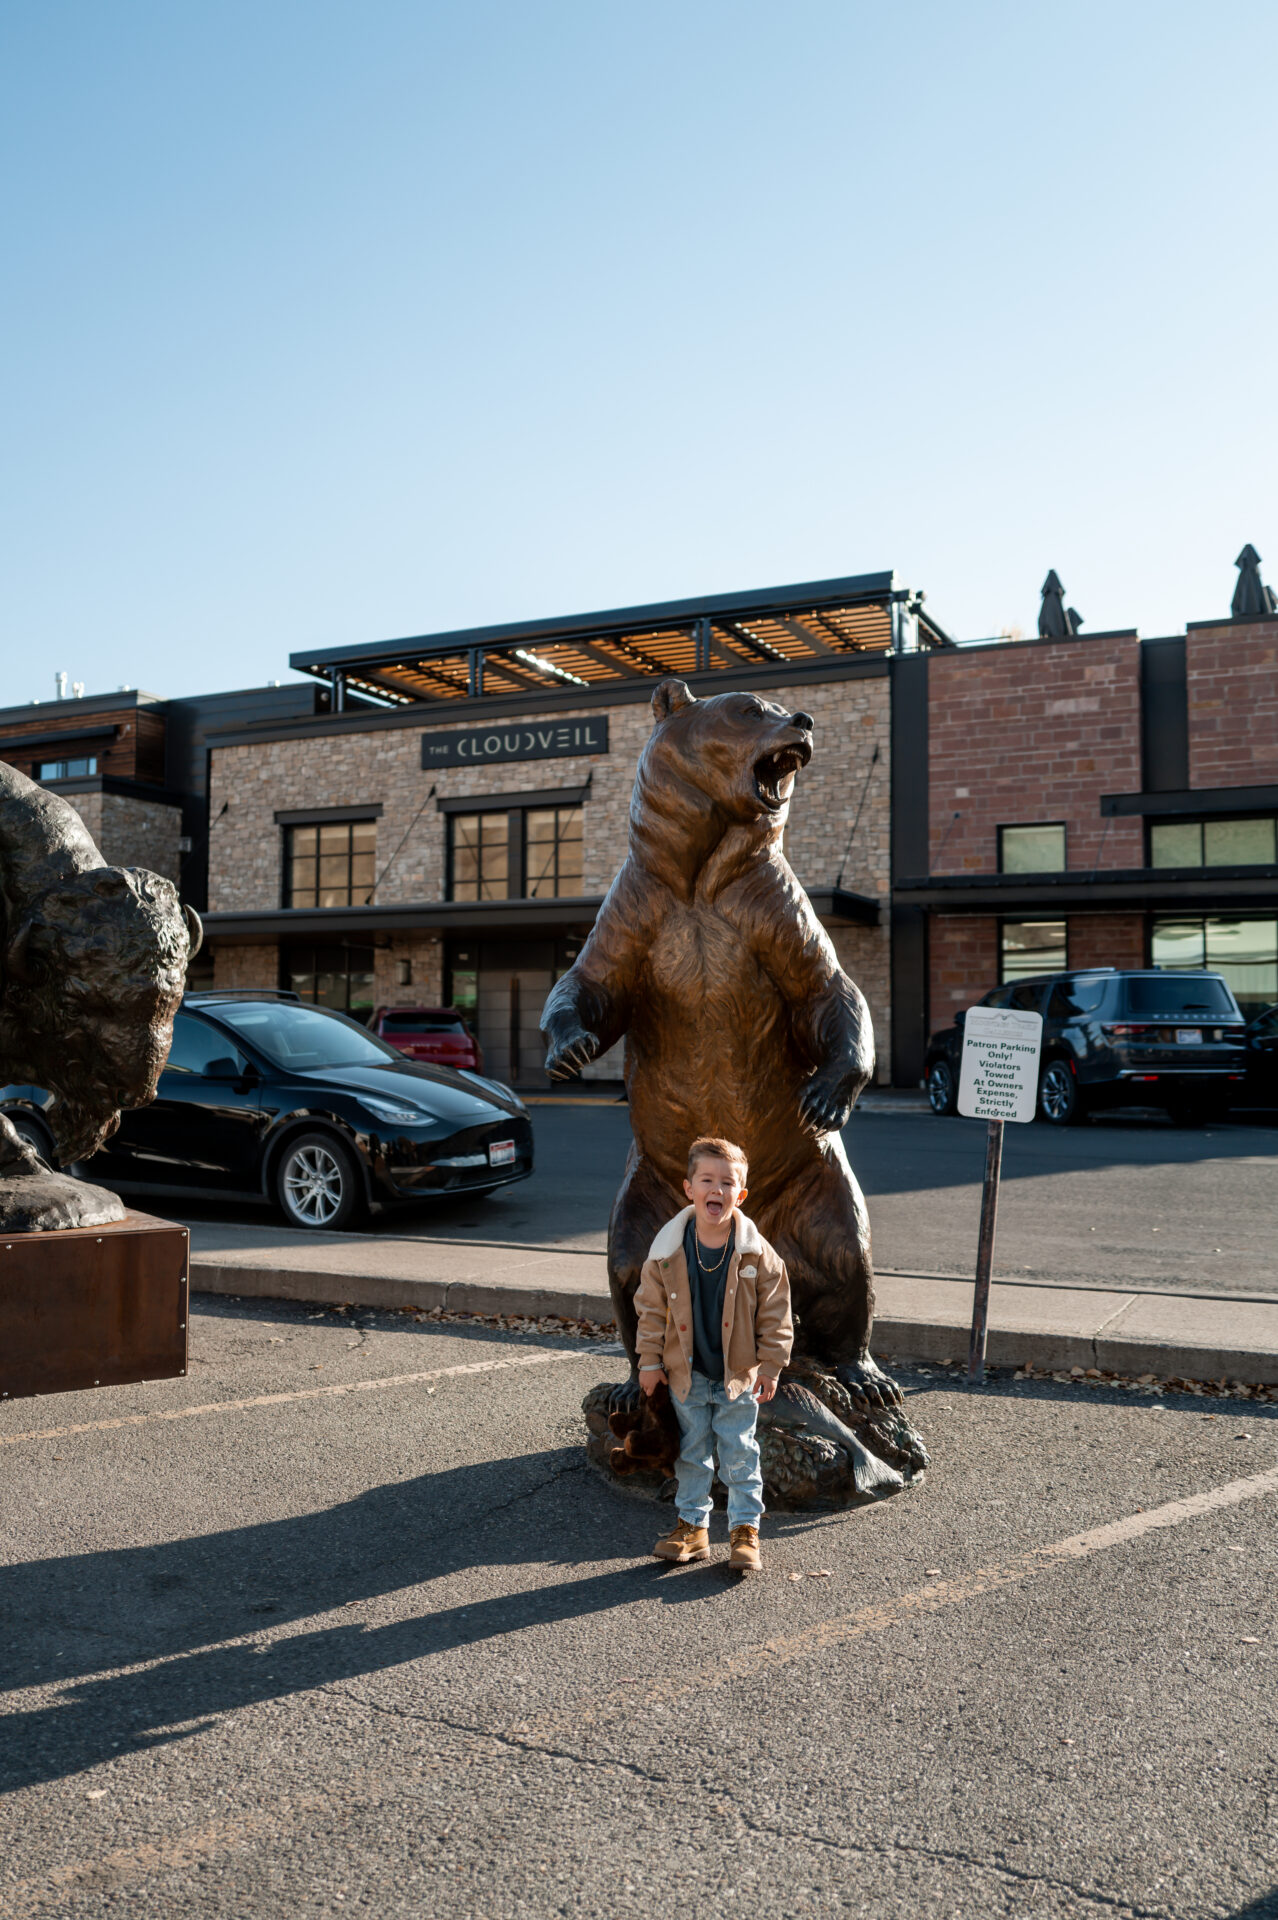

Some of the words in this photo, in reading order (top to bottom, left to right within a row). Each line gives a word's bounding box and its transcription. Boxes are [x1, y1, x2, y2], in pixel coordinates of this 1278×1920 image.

[429, 744, 449, 755] THE
[457, 726, 598, 757] CLOUDVEIL
[967, 1039, 997, 1049] Patron
[1000, 1042, 1036, 1054] Parking
[988, 1051, 1013, 1061] Only!
[979, 1060, 1021, 1071] Violators
[984, 1070, 1015, 1080] Towed
[973, 1078, 985, 1086] At
[987, 1079, 1024, 1090] Owners
[976, 1087, 1018, 1099] Expense,
[979, 1097, 1014, 1108] Strictly
[974, 1106, 1017, 1118] Enforced
